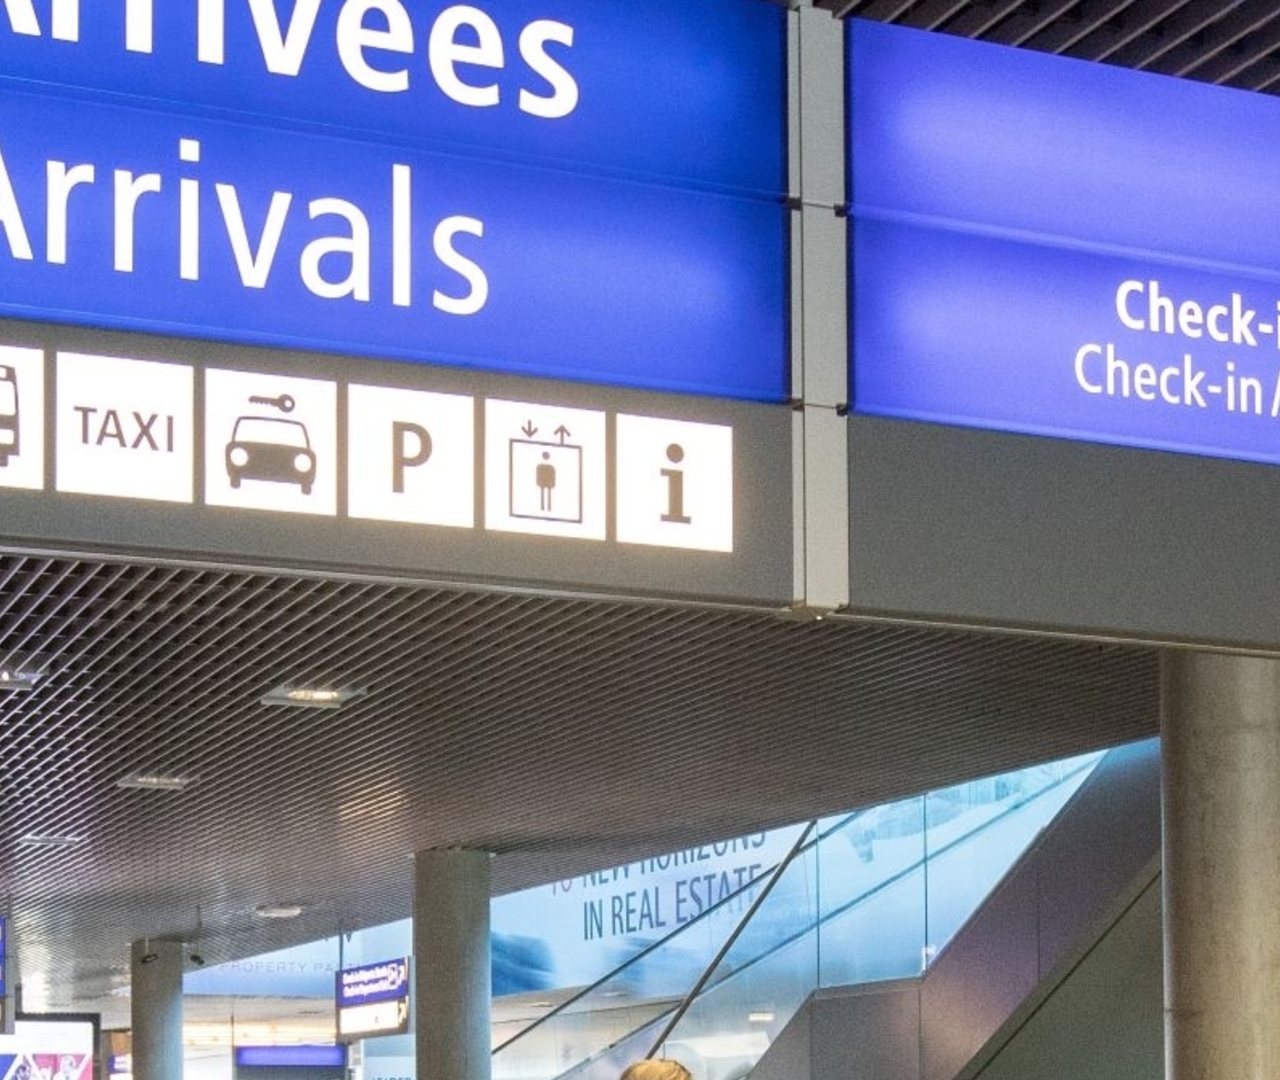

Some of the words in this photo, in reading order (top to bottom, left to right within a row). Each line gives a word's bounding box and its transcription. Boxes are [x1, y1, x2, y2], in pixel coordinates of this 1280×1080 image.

[1073, 343, 1263, 414] Check-in
[73, 405, 176, 453] TAXI
[583, 898, 604, 941] IN
[611, 885, 666, 936] REAL
